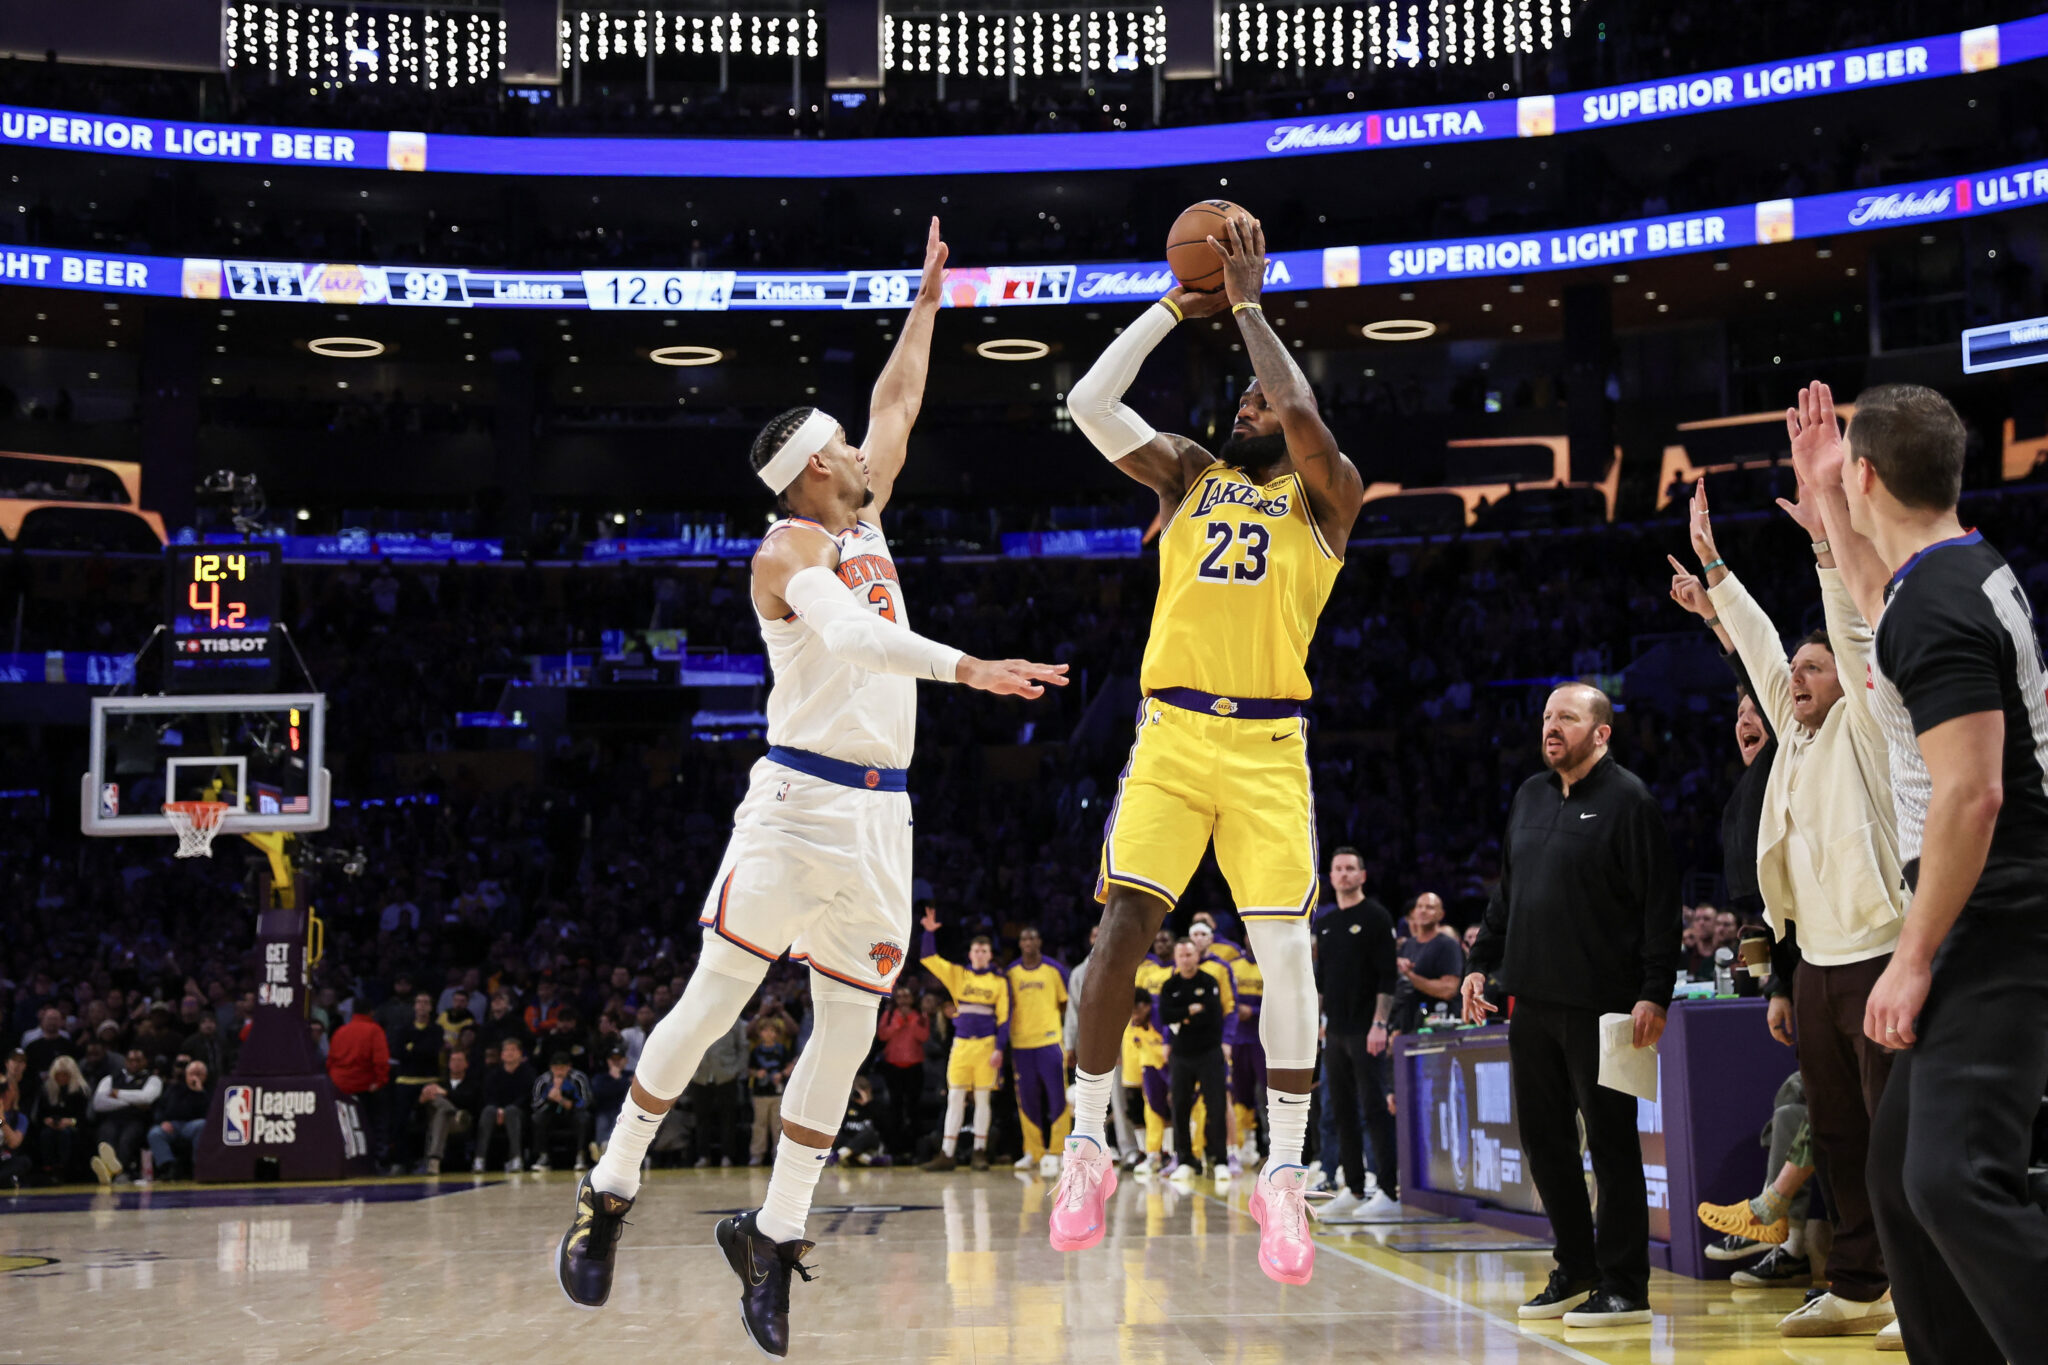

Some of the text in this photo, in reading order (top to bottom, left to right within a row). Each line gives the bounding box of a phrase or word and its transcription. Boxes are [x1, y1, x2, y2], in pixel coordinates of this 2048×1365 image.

[1582, 46, 1929, 123] SUPERIOR LIGHT BEER
[0, 112, 355, 162] UPERIOR LIGHT BEER
[1386, 109, 1484, 141] ULTRA
[1976, 168, 2048, 207] ULTR
[1388, 216, 1726, 277] SUPERIOR LIGHT BEER
[62, 256, 148, 289] BEER
[404, 271, 448, 301] 99
[493, 280, 564, 300] Lakers
[606, 277, 683, 305] 12.6
[755, 281, 826, 301] Knicks
[867, 275, 910, 304] 99
[1190, 477, 1290, 519] LAKERS
[194, 554, 246, 582] 12.4
[1197, 520, 1272, 586] 23
[189, 581, 247, 629] 4.2
[200, 637, 268, 652] TISSOT
[265, 943, 290, 962] GET
[255, 1086, 317, 1120] League
[253, 1115, 297, 1145] Pass
